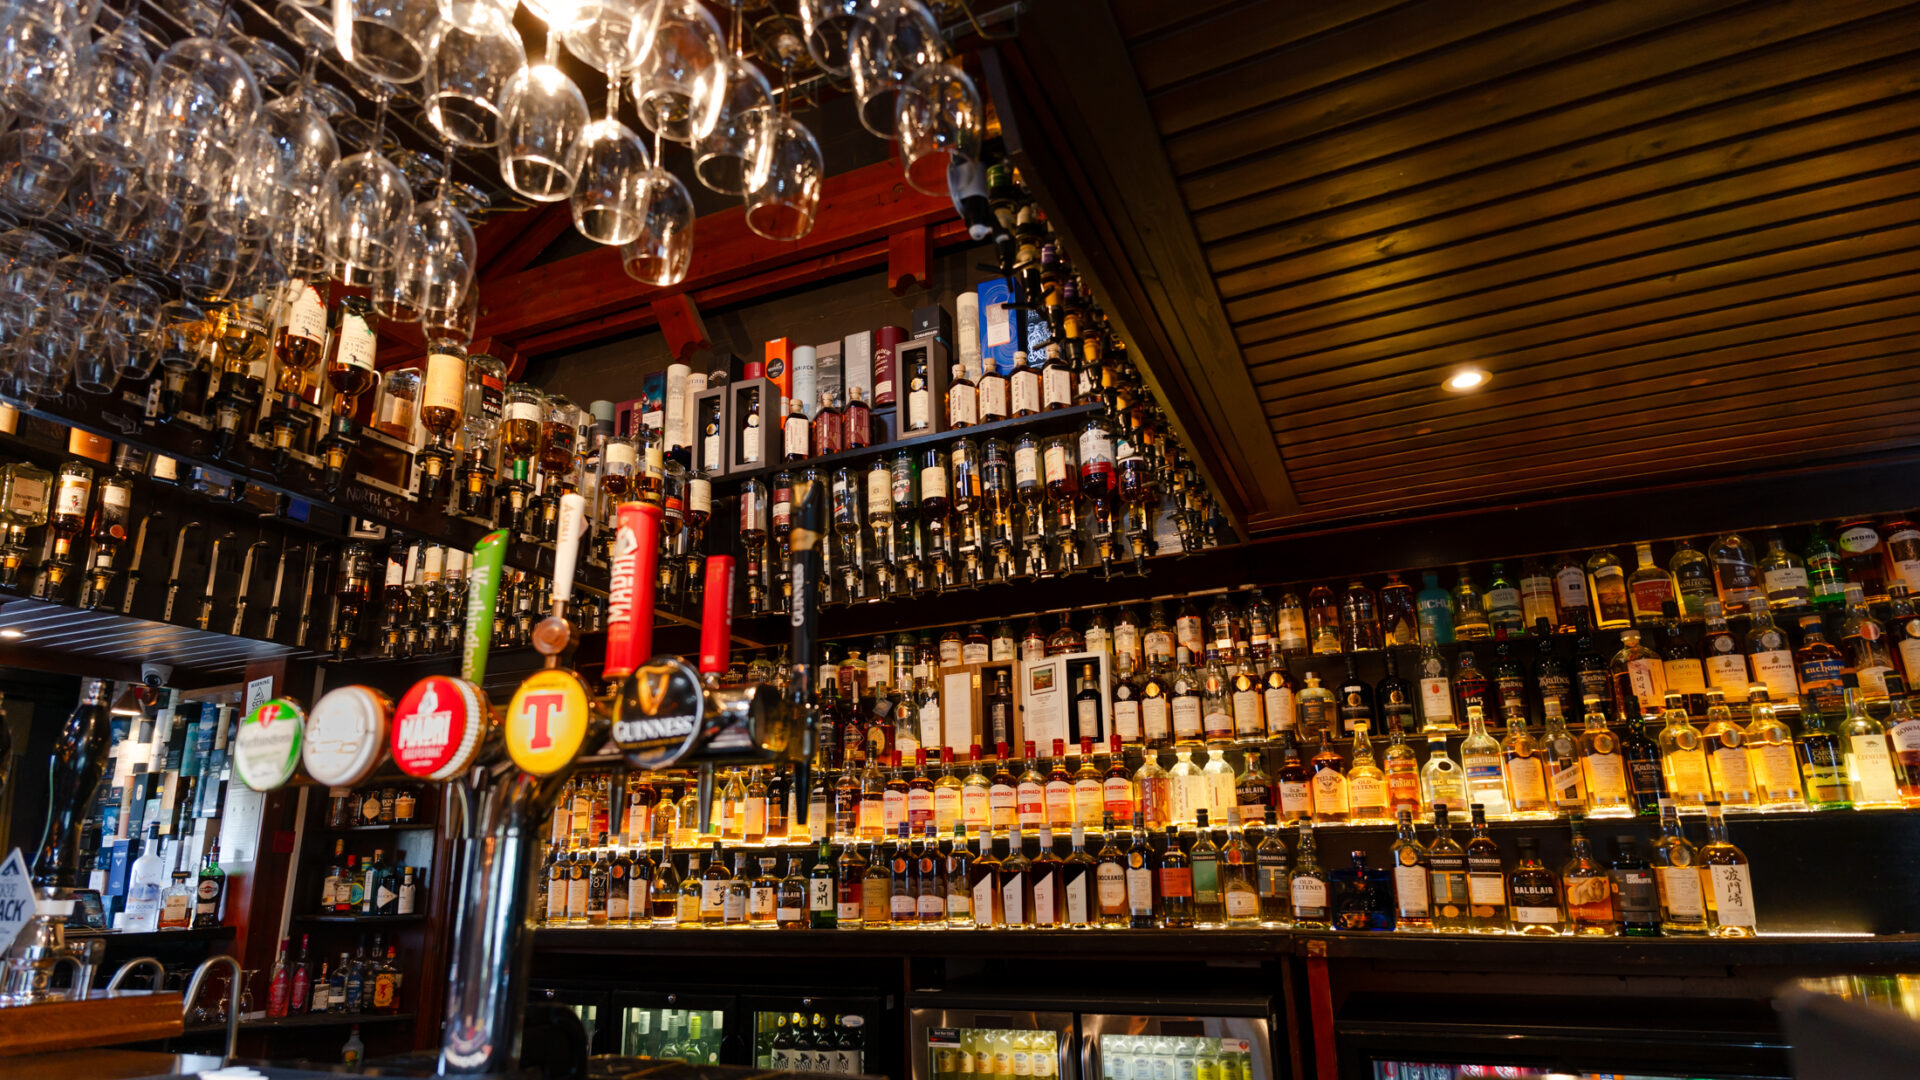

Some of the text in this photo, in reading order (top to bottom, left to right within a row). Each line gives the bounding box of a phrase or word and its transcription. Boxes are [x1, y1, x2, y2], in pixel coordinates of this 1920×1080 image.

[522, 693, 564, 749] T
[613, 714, 695, 743] GUINNESS
[1142, 780, 1150, 821] RAASAY
[816, 881, 828, 906] 白州
[1514, 886, 1554, 895] BALBLAIR
[0, 899, 26, 922] ACK
